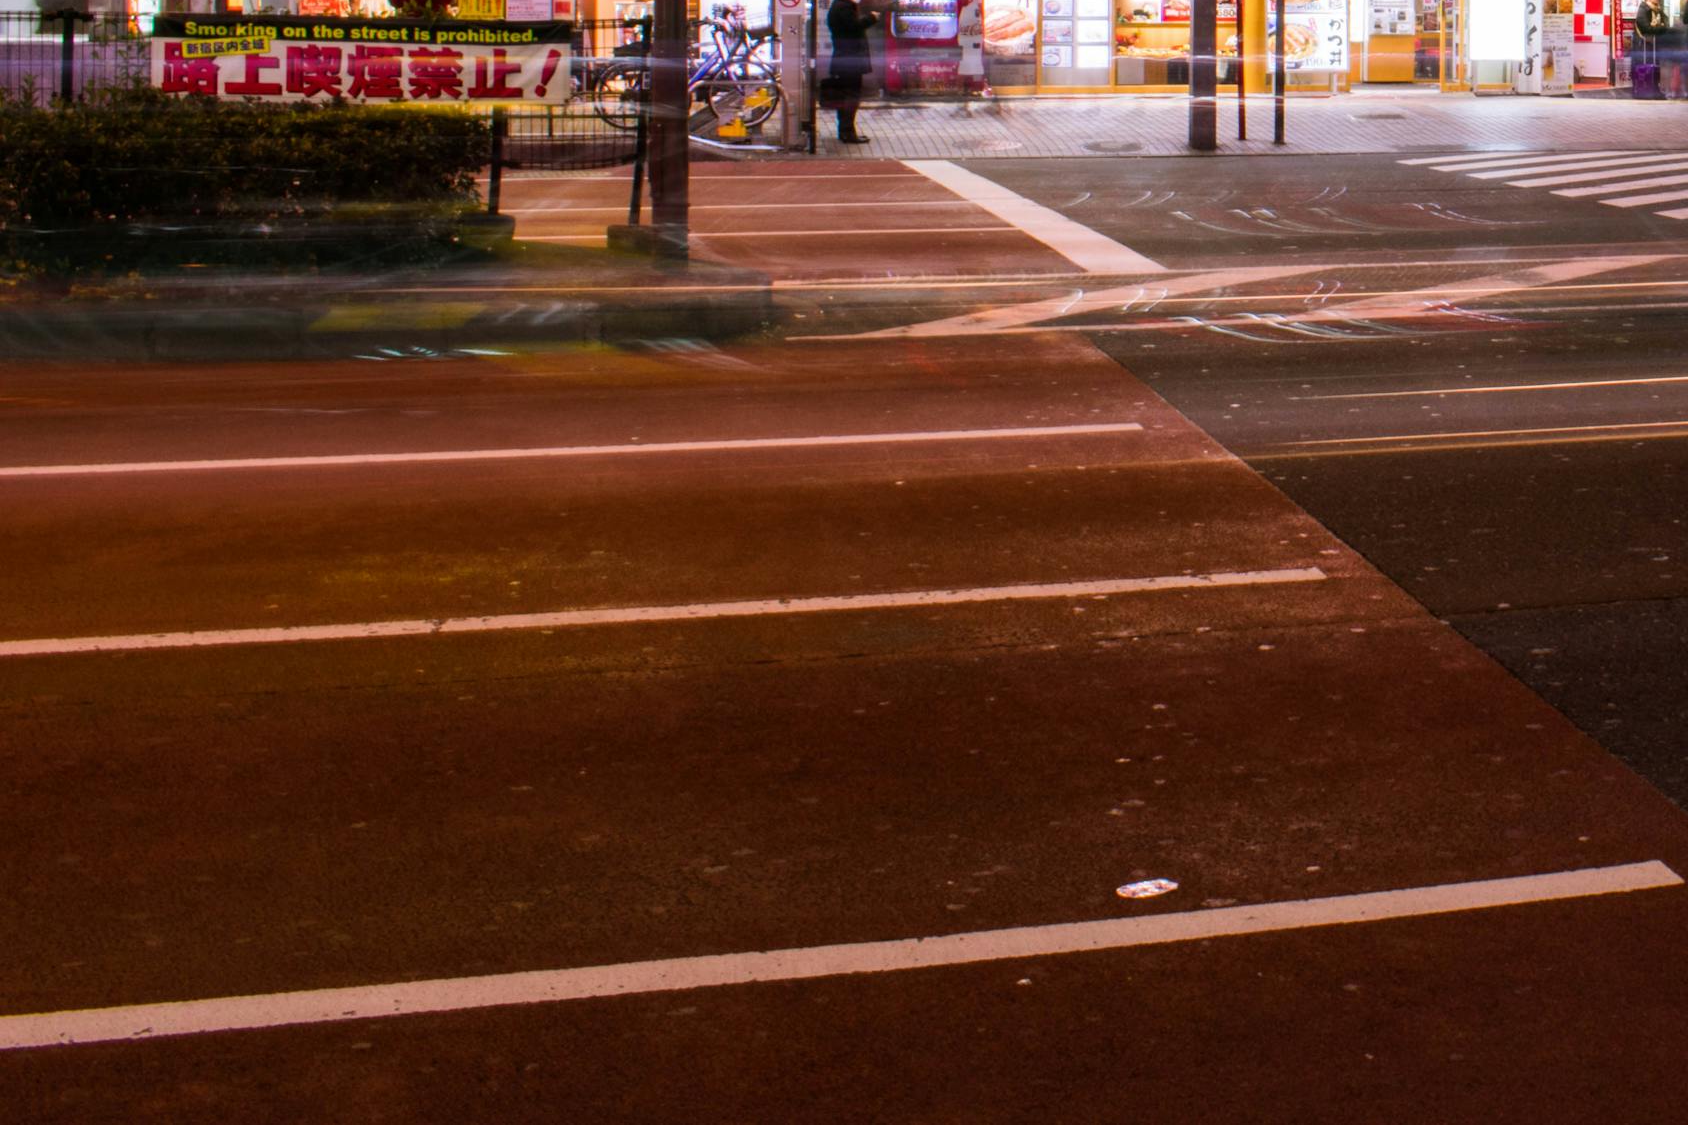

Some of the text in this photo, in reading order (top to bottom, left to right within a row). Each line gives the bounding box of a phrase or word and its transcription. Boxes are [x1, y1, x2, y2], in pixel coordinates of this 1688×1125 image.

[186, 39, 266, 55] 新宿区内全域
[283, 25, 308, 38] on
[313, 25, 344, 40] the
[349, 26, 403, 41] street
[413, 28, 430, 42] is
[435, 28, 539, 44] prohibited.
[1327, 18, 1345, 66] かつ丼
[161, 41, 562, 99] 路上喫煙禁止!
